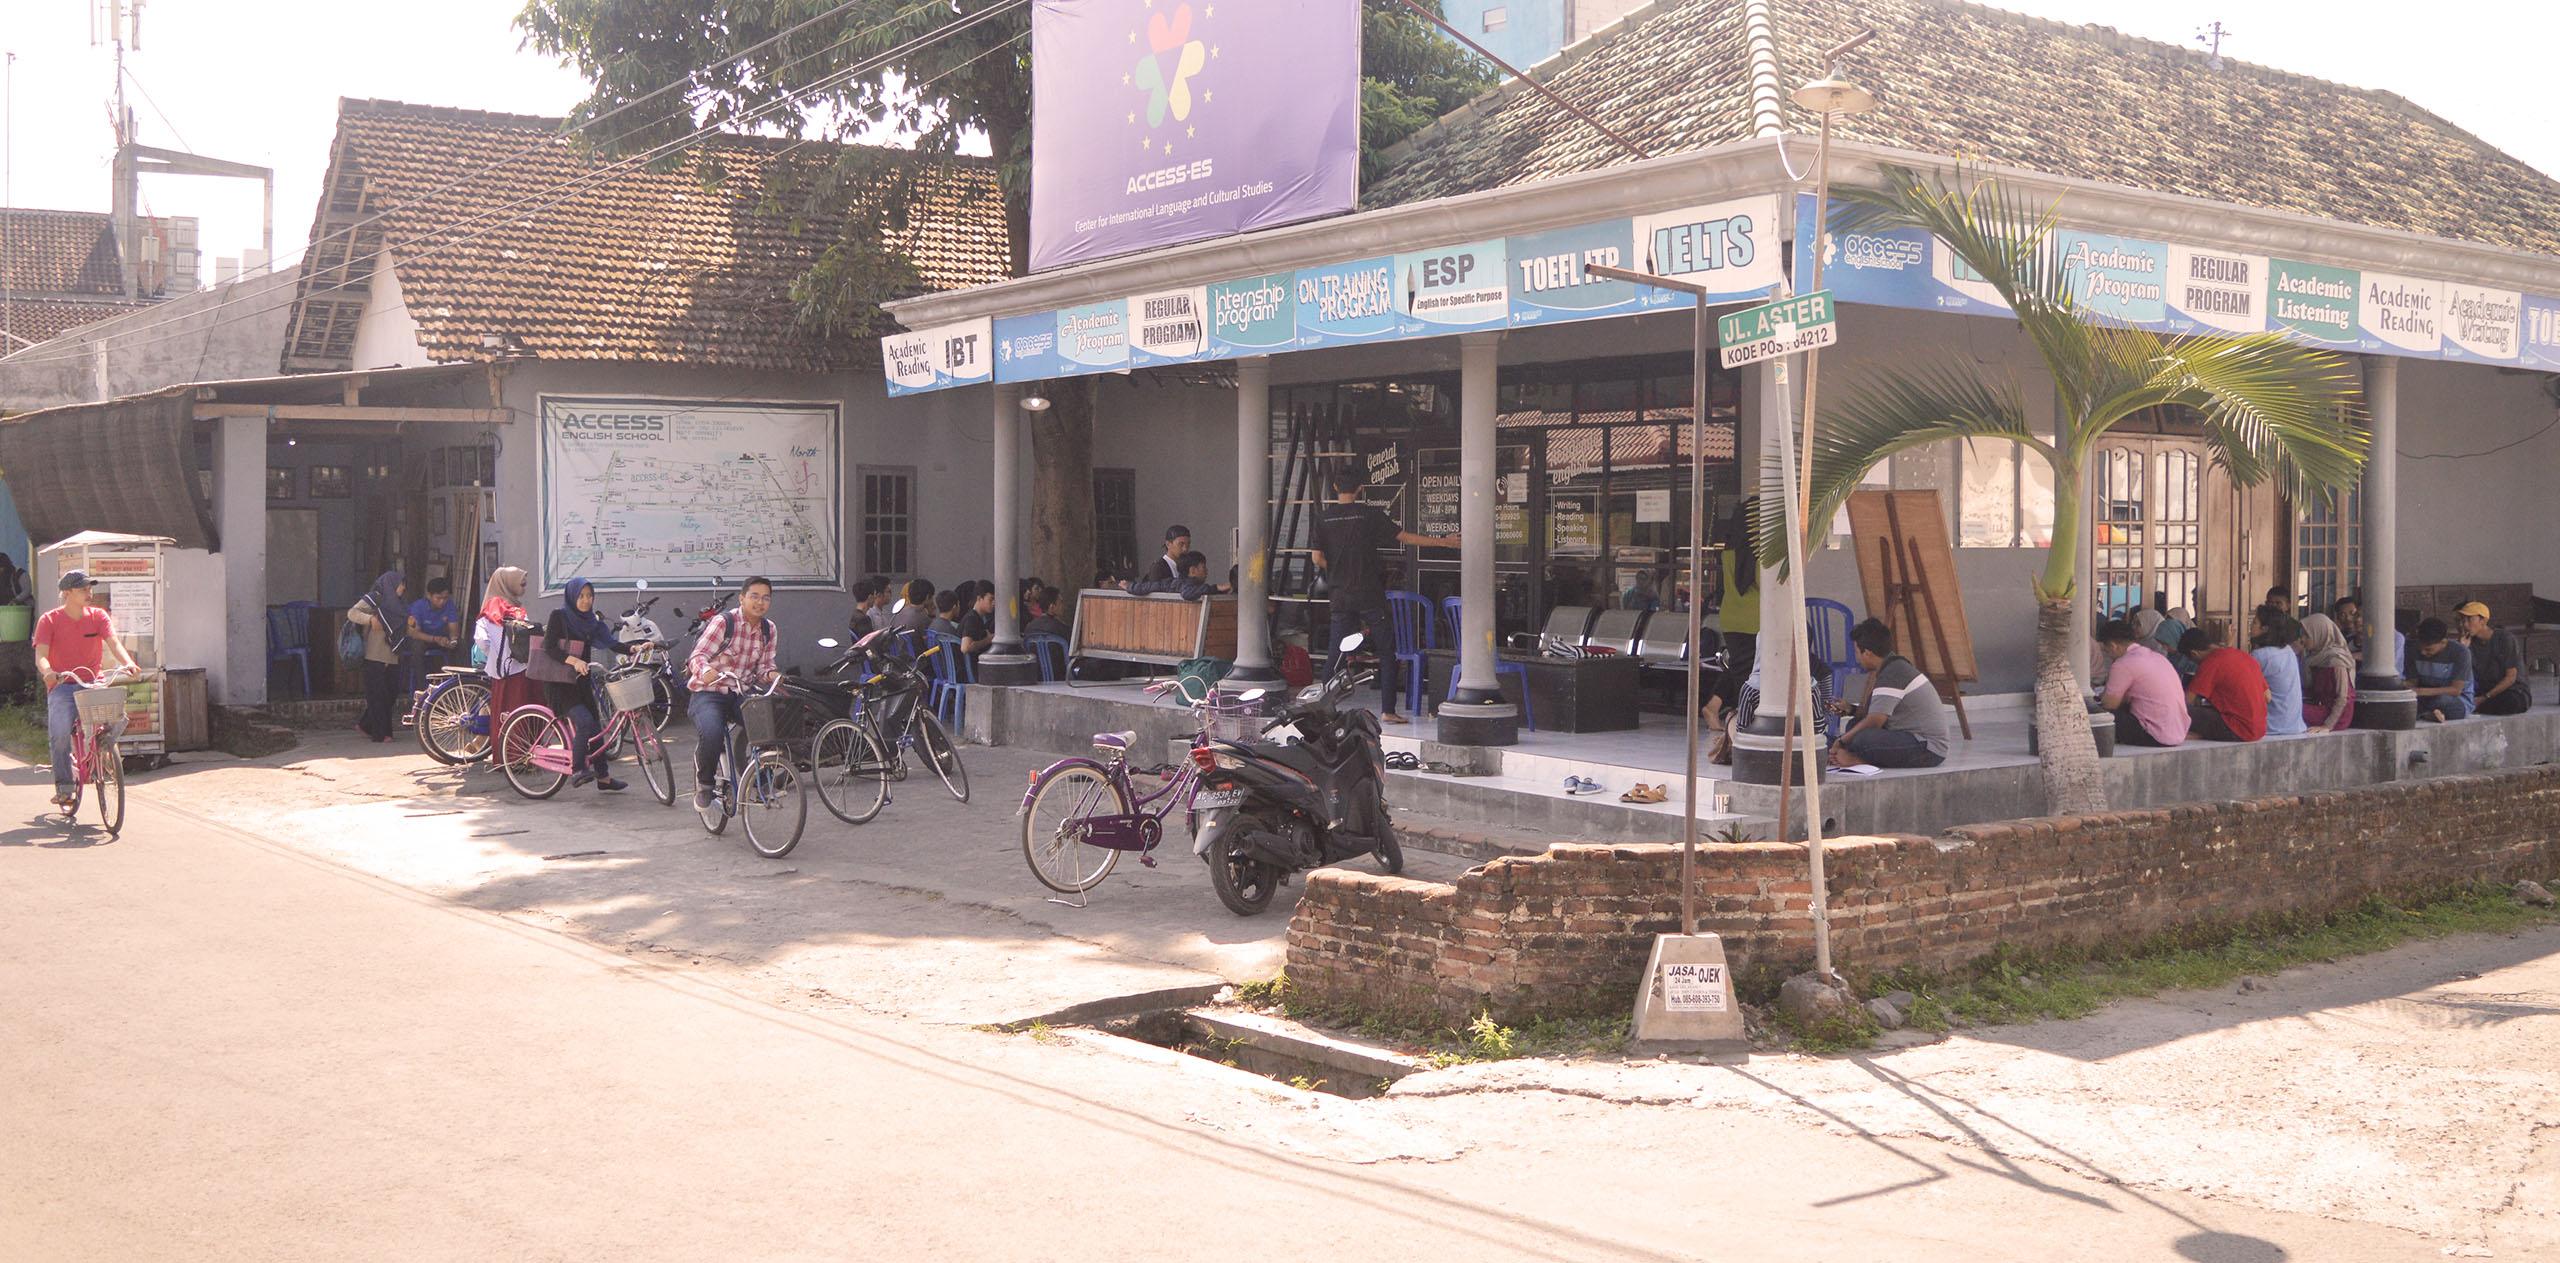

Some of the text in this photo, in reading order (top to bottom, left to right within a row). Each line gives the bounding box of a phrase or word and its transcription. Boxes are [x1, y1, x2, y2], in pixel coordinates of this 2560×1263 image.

[1126, 158, 1213, 195] ACCESS-ES
[1075, 181, 1273, 233] Center for International Language and Cultural Studies
[1654, 214, 1755, 277] IELTS
[1844, 234, 1923, 265] access
[2065, 241, 2155, 273] Academic
[1423, 253, 1475, 289] ESP
[1520, 252, 1580, 294] TOEFL
[2190, 255, 2249, 285] REGULAR
[2277, 271, 2352, 300] Academic
[1215, 278, 1285, 312] Internship
[1298, 267, 1388, 305] ON TRAINING
[1417, 290, 1503, 310] English for Specific Purpose
[2086, 271, 2160, 305] Program
[2185, 286, 2250, 317] PROGRAM
[1144, 296, 1191, 320] REGULAR
[1216, 302, 1275, 335] program
[1318, 288, 1392, 323] PROGRAM
[1724, 296, 1826, 343] JL. ASTER
[2276, 298, 2350, 330] Listening
[2449, 289, 2516, 324] Academic
[1061, 309, 1120, 337] Academic
[1143, 321, 1198, 346] PROGRAM
[2458, 316, 2511, 353] Writing
[945, 334, 977, 369] IBT
[1074, 331, 1124, 357] Program
[1727, 344, 1757, 364] KODE
[561, 431, 664, 441] ENGLISH SCHOOL
[562, 413, 664, 431] ACCESS
[1367, 441, 1397, 472] General
[1370, 459, 1400, 485] english
[1422, 476, 1442, 488] OPEN
[1426, 493, 1459, 503] WEEKDAYS
[1426, 523, 1459, 533] WEEKENDS
[1669, 966, 1720, 983] JASA. OJEK
